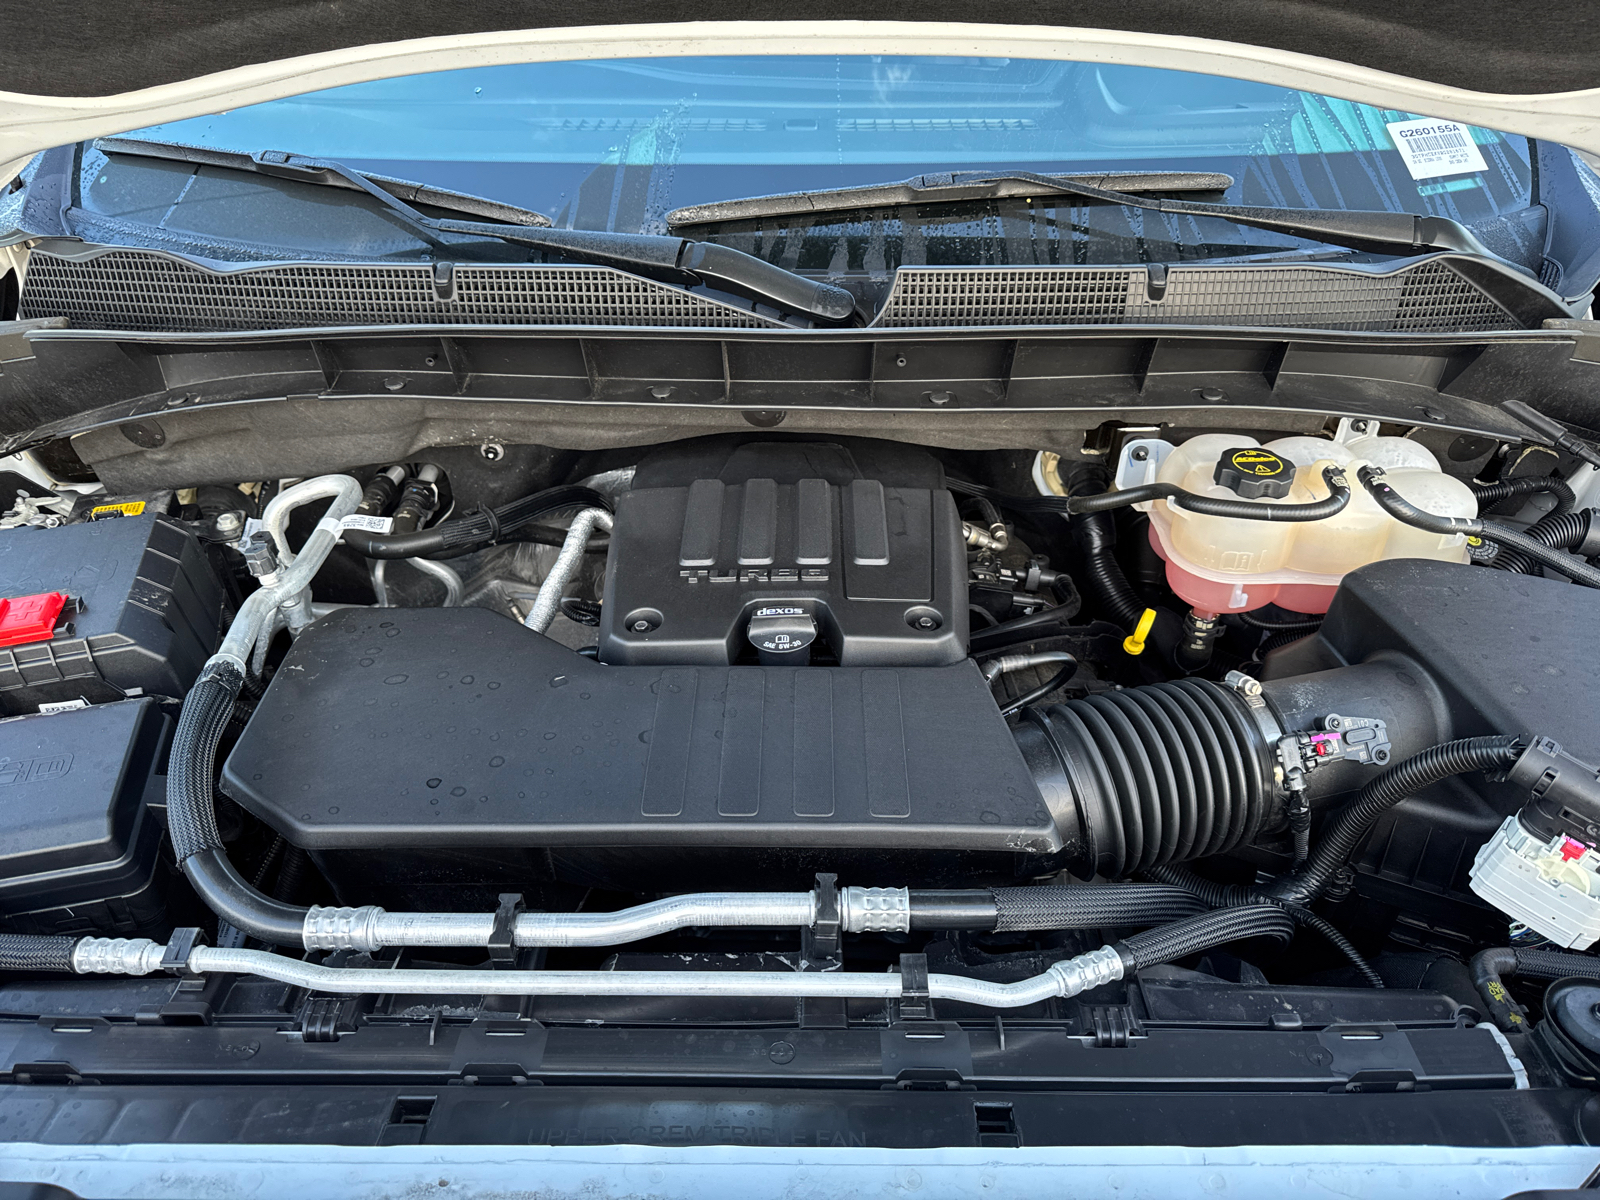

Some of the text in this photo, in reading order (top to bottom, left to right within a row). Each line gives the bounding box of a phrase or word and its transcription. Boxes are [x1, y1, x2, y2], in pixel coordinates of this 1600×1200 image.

[680, 568, 830, 583] TURBO
[757, 607, 804, 616] dexos
[763, 640, 802, 649] SAE 5W-30
[527, 1126, 620, 1144] UPPER
[815, 1129, 867, 1147] FAN
